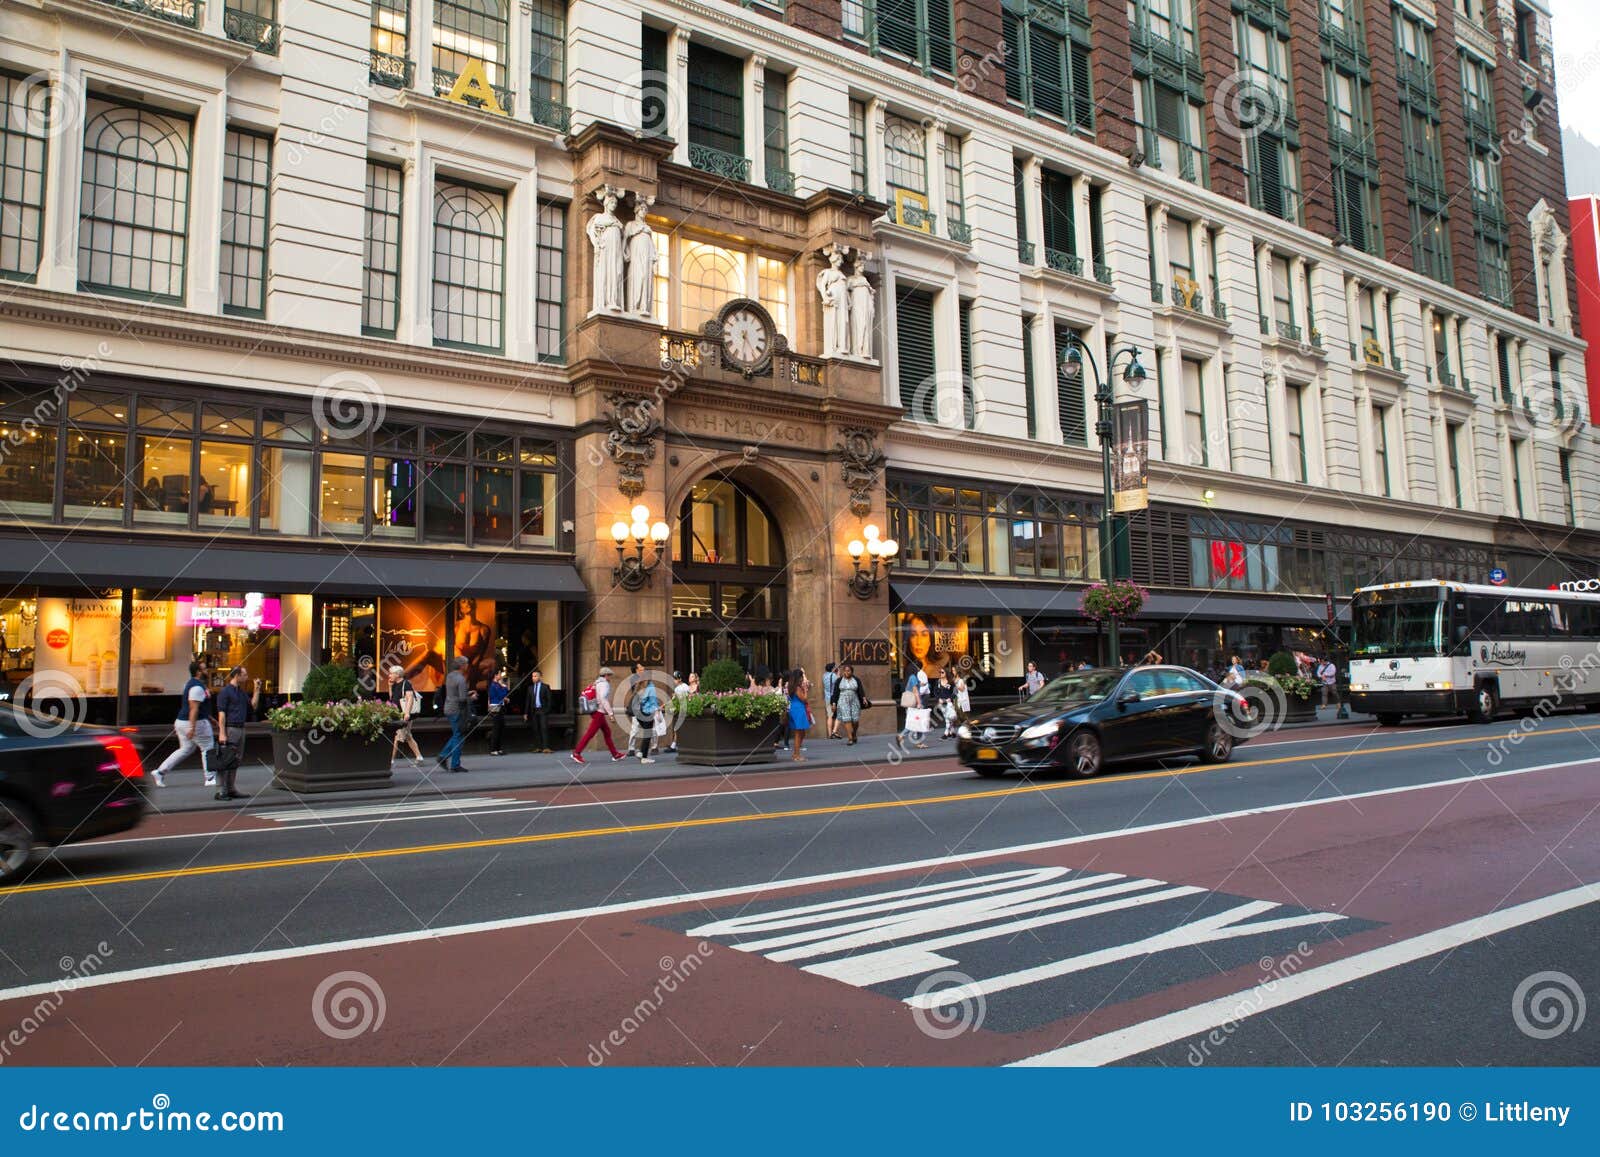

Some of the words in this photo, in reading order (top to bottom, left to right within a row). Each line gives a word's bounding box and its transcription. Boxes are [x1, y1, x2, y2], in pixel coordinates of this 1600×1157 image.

[440, 57, 508, 116] A
[1559, 578, 1600, 592] mac
[1490, 641, 1527, 666] Academy
[1378, 671, 1412, 682] Academy
